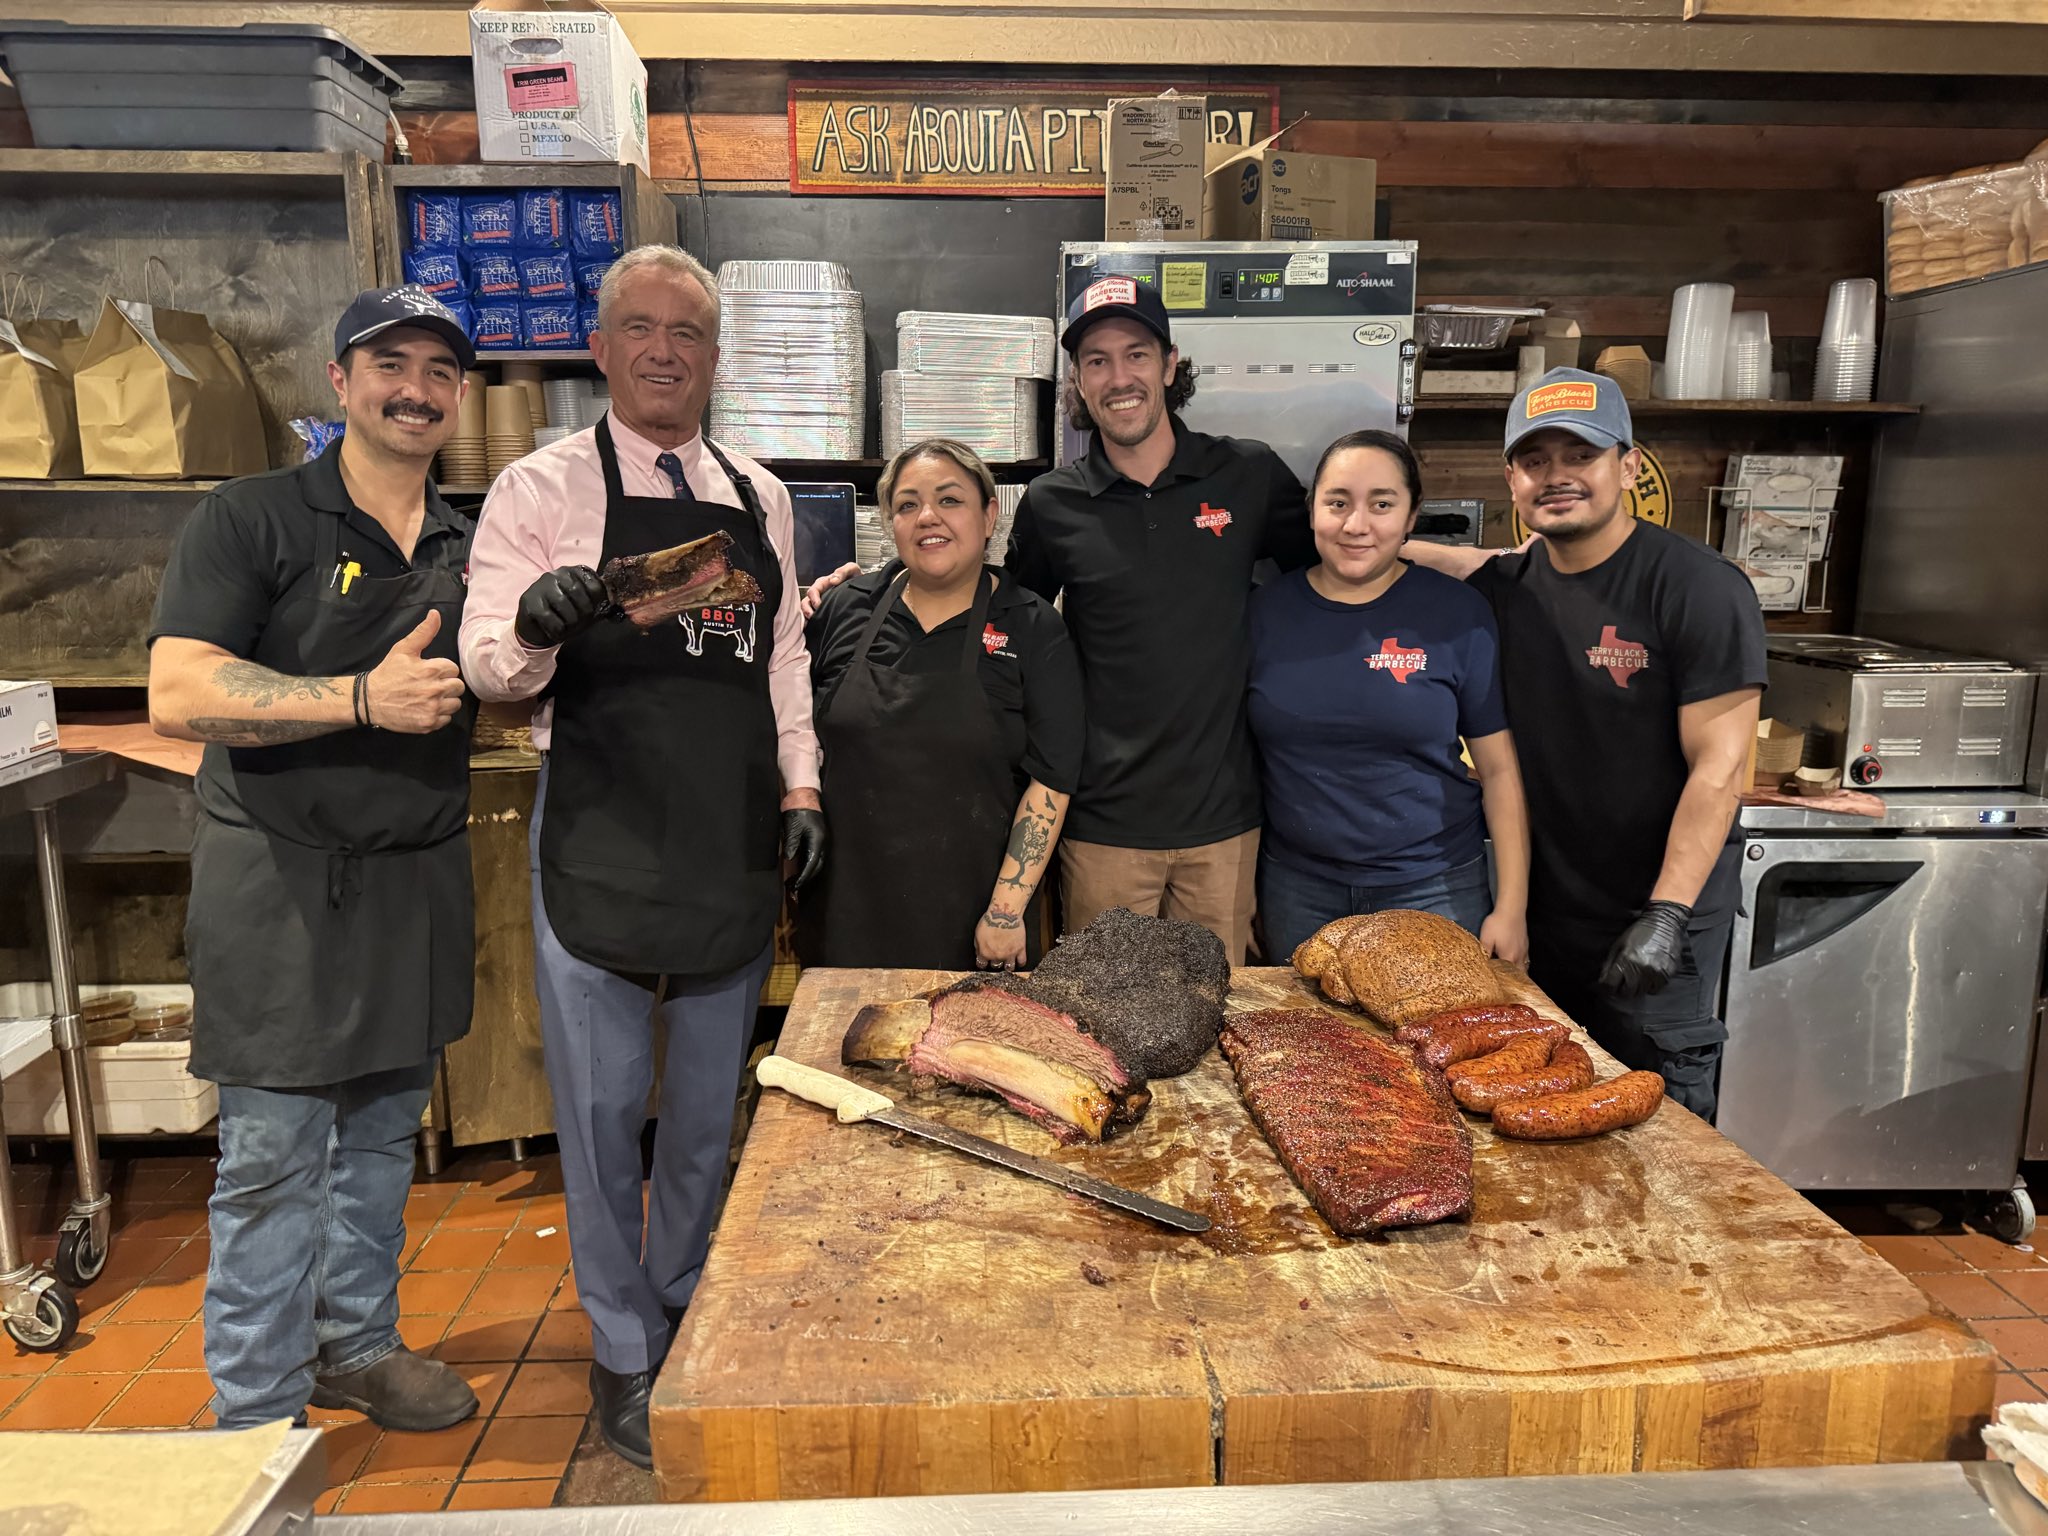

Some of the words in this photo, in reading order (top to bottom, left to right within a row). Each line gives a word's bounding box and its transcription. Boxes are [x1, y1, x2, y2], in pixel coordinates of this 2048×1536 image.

[480, 22, 509, 33] KEEP
[512, 111, 559, 119] PRODUCT
[562, 110, 577, 119] OF
[531, 122, 560, 130] U.S.A.
[532, 134, 572, 143] MEXICO
[812, 102, 892, 174] ASK
[903, 103, 1003, 174] ABOUT
[1112, 186, 1140, 194] A7SPBL
[1271, 184, 1292, 195] Tongs
[471, 213, 509, 221] EXTRA
[541, 196, 550, 235] THIN
[1271, 215, 1311, 226] S64001FB
[426, 206, 435, 240] THIN
[472, 221, 508, 231] THIN
[586, 203, 598, 242] EXTRA
[593, 204, 607, 241] THIN
[481, 266, 516, 275] EXTRA
[526, 266, 563, 276] EXTRA
[481, 273, 518, 284] THIN
[527, 274, 563, 285] THIN
[1253, 273, 1279, 284] 140F
[1090, 288, 1129, 300] BARBECUE
[532, 316, 568, 325] EXTRA
[532, 323, 568, 334] THIN
[1359, 329, 1376, 337] HALO
[1532, 399, 1591, 413] BARBECUE
[1195, 517, 1233, 528] BARBECUE
[702, 608, 735, 623] BBQ
[1370, 653, 1395, 661] TERRY
[1396, 653, 1428, 662] BLACK'S
[1591, 646, 1613, 656] TERRY
[1614, 648, 1649, 658] BLACK'S
[1369, 660, 1427, 671] BARBECUE
[1589, 655, 1649, 669] BARBECUE
